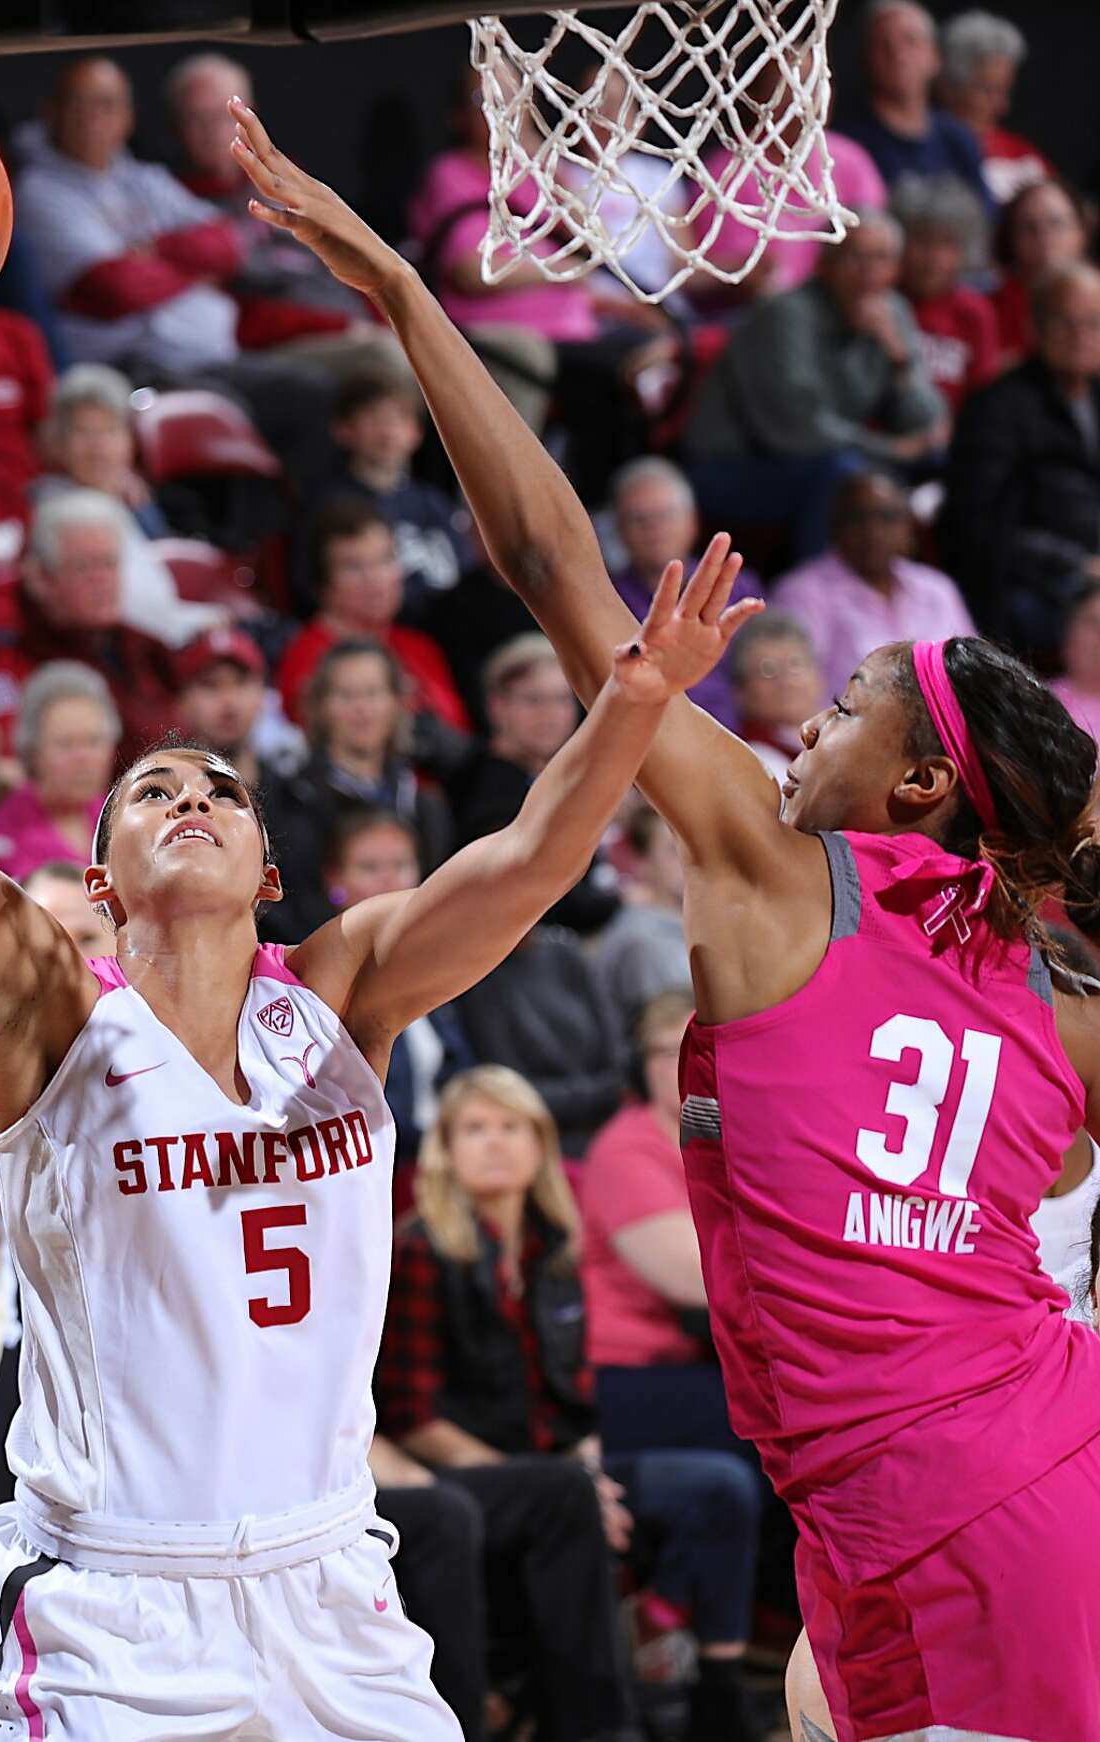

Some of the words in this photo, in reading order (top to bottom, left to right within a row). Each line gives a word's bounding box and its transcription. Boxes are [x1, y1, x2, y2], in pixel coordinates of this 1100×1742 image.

[272, 1012, 291, 1031] 12
[855, 1013, 1002, 1198] 31
[113, 1110, 373, 1196] STANFORD
[843, 1191, 982, 1255] ANIGWE
[240, 1204, 311, 1329] 5
